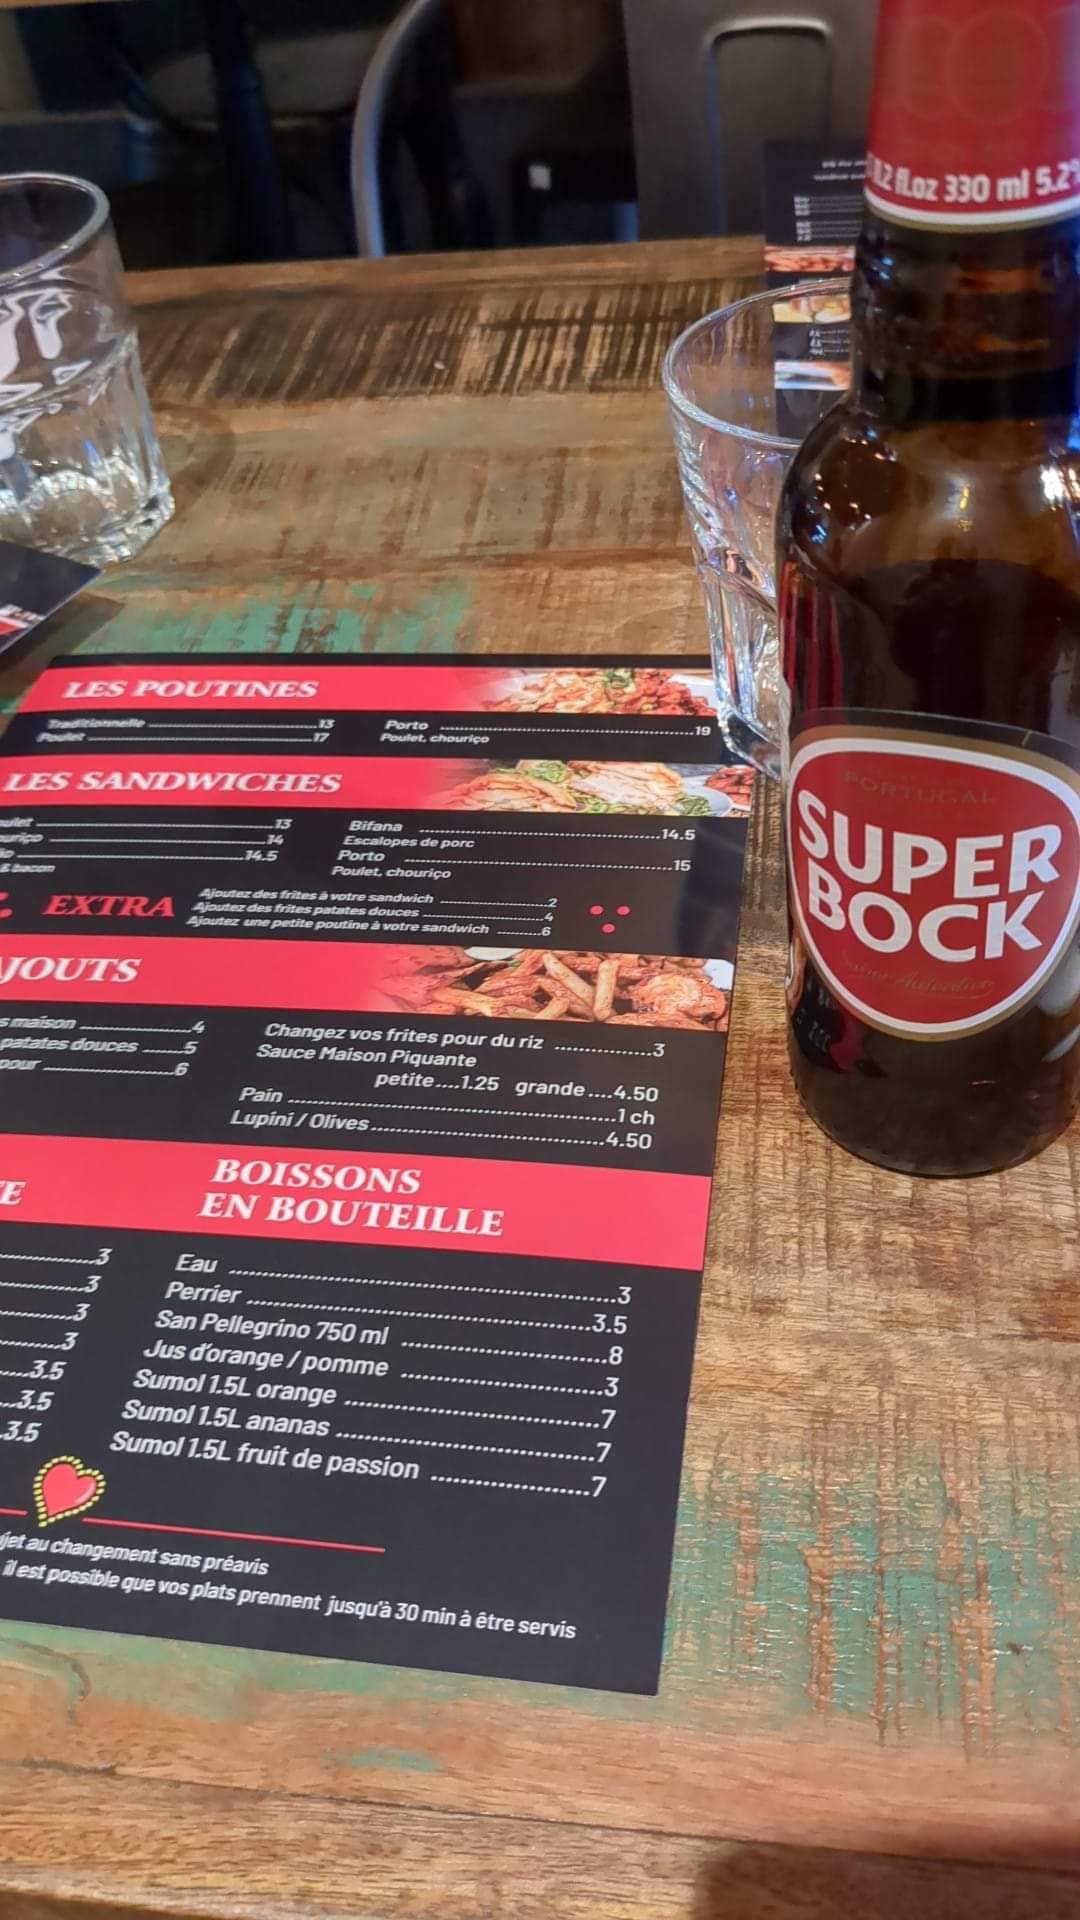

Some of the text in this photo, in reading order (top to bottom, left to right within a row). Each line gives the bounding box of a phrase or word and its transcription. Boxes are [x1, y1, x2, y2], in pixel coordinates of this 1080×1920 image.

[944, 174, 990, 203] 330
[997, 168, 1030, 202] ml
[63, 680, 319, 698] LES POUTINES
[318, 719, 335, 729] 13
[385, 720, 711, 737] Porto 19
[36, 732, 330, 742] Poulet 17
[430, 733, 490, 745] chouriço
[2, 771, 344, 793] LES SANDWICHES
[274, 818, 293, 829] 13
[349, 820, 696, 841] Bifana 14.5
[266, 835, 285, 846] 14
[343, 836, 475, 850] Escalopes de porc
[798, 789, 1062, 899] SUPER
[244, 850, 279, 862] 14.5
[337, 850, 691, 872] Porto 15
[385, 867, 452, 880] chouriço
[42, 895, 175, 918] EXTRA
[199, 888, 557, 908] Ajoutez des frites à votre sandwich 2
[192, 902, 554, 922] Ajoutez des frites patates douces 4
[807, 857, 1045, 963] BOCK
[186, 915, 551, 936] Ajoutez une petite poutine à votre sandwich 6
[0, 956, 143, 984] JOUTS
[9, 1016, 76, 1029] maison
[192, 1021, 206, 1033] 4
[0, 1036, 199, 1054] patates douces 5
[264, 1023, 665, 1058] Changez vos frites pour du riz 3
[256, 1044, 477, 1068] Sauce Maison Piquante
[174, 1062, 190, 1076] 6
[238, 1087, 656, 1125] Pain 1 ch
[230, 1110, 294, 1128] Lupini
[308, 1114, 370, 1131] Olives
[605, 1133, 653, 1150] 4.50
[211, 1158, 422, 1195] BOISSONS
[0, 1180, 27, 1204] E
[197, 1192, 505, 1236] EN BOUTEILLE
[95, 1248, 112, 1265] 3
[84, 1275, 102, 1293] 3
[175, 1253, 632, 1305] Eau 3
[72, 1303, 91, 1321] 3
[164, 1280, 628, 1335] Perrier 3.5
[60, 1331, 79, 1350] 3
[154, 1309, 623, 1366] San Pellegrino 750 ml 8
[28, 1359, 68, 1381] 3.5
[143, 1339, 620, 1398] Jus d'orange / pomme 3
[15, 1389, 55, 1411] 3.5
[133, 1368, 617, 1430] Sumol 1.5L orange 7
[2, 1420, 43, 1443] 3.5
[121, 1399, 612, 1463] Sumol 1.5L ananas 7
[110, 1430, 607, 1497] Sumol 1.5L fruit de passion 7
[25, 1538, 50, 1551] au
[50, 1538, 159, 1562] changement
[158, 1550, 202, 1568] sans
[202, 1555, 270, 1576] préavis
[2, 1559, 577, 1640] il est possible que vos plats prennent jusqu'à 30 min à être servis
